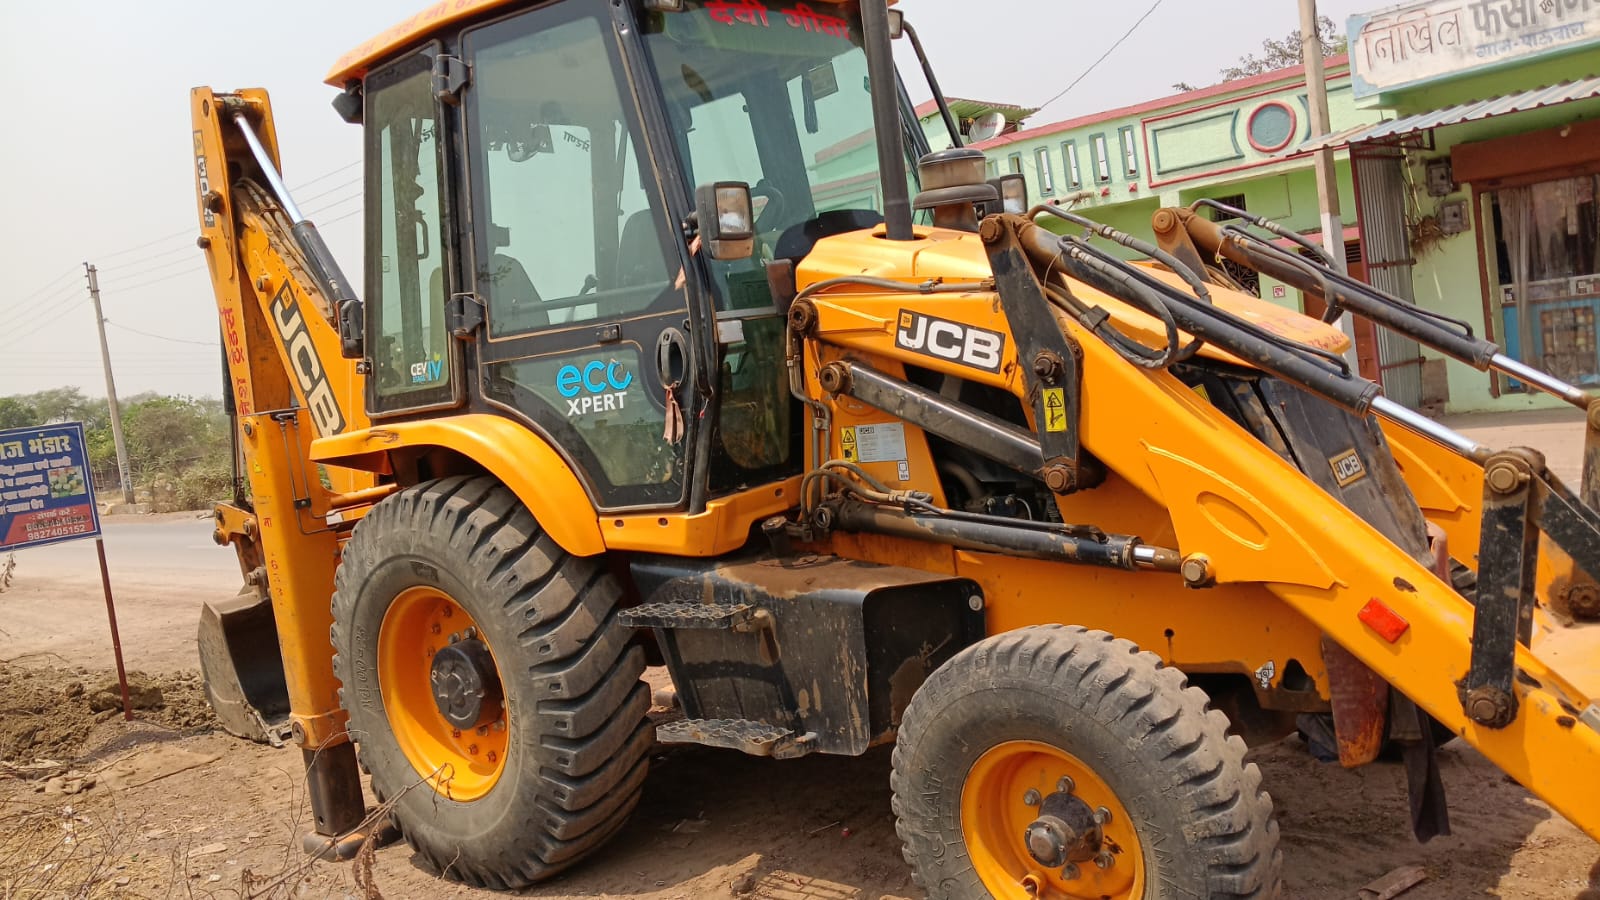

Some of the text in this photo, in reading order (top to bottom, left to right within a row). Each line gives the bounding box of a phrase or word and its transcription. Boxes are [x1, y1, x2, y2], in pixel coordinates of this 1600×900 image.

[1361, 8, 1463, 72] निखिल
[899, 316, 1001, 369] JCB
[273, 299, 340, 438] JCB
[410, 362, 428, 377] CEV
[556, 359, 633, 397] eco
[567, 392, 627, 416] XPERT
[28, 433, 72, 455] भंडार
[1338, 455, 1361, 480] JCB
[27, 524, 85, 541] 9827405152
